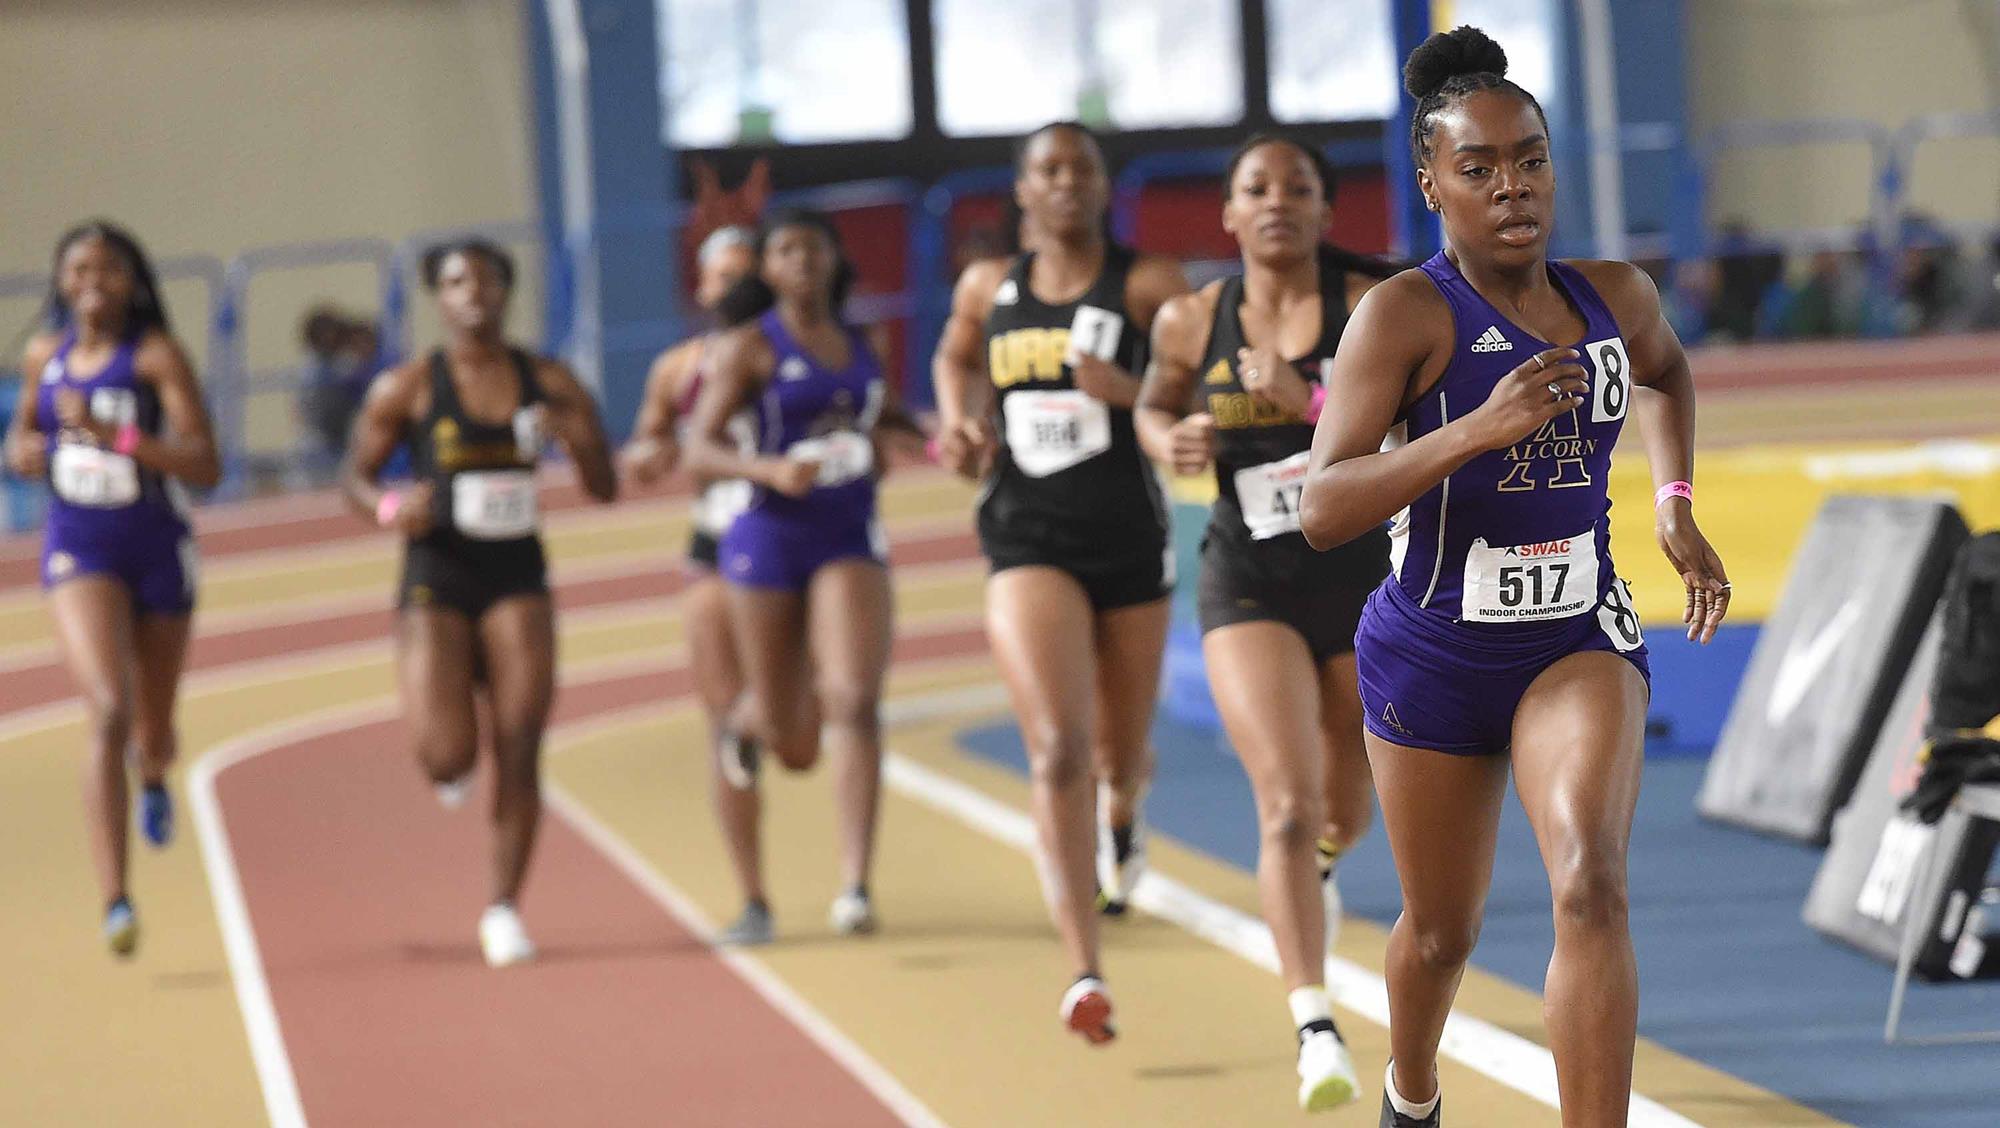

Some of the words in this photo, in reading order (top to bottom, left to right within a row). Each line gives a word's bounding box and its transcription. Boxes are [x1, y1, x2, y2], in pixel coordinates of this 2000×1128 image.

[1471, 340, 1513, 352] adidas
[1600, 344, 1624, 417] 8
[1504, 439, 1599, 461] ALCORN
[1520, 540, 1571, 556] SWAC
[1500, 563, 1570, 607] 517
[1479, 608, 1516, 617] INDOOR
[1518, 600, 1585, 617] CHAMPIONSHIP
